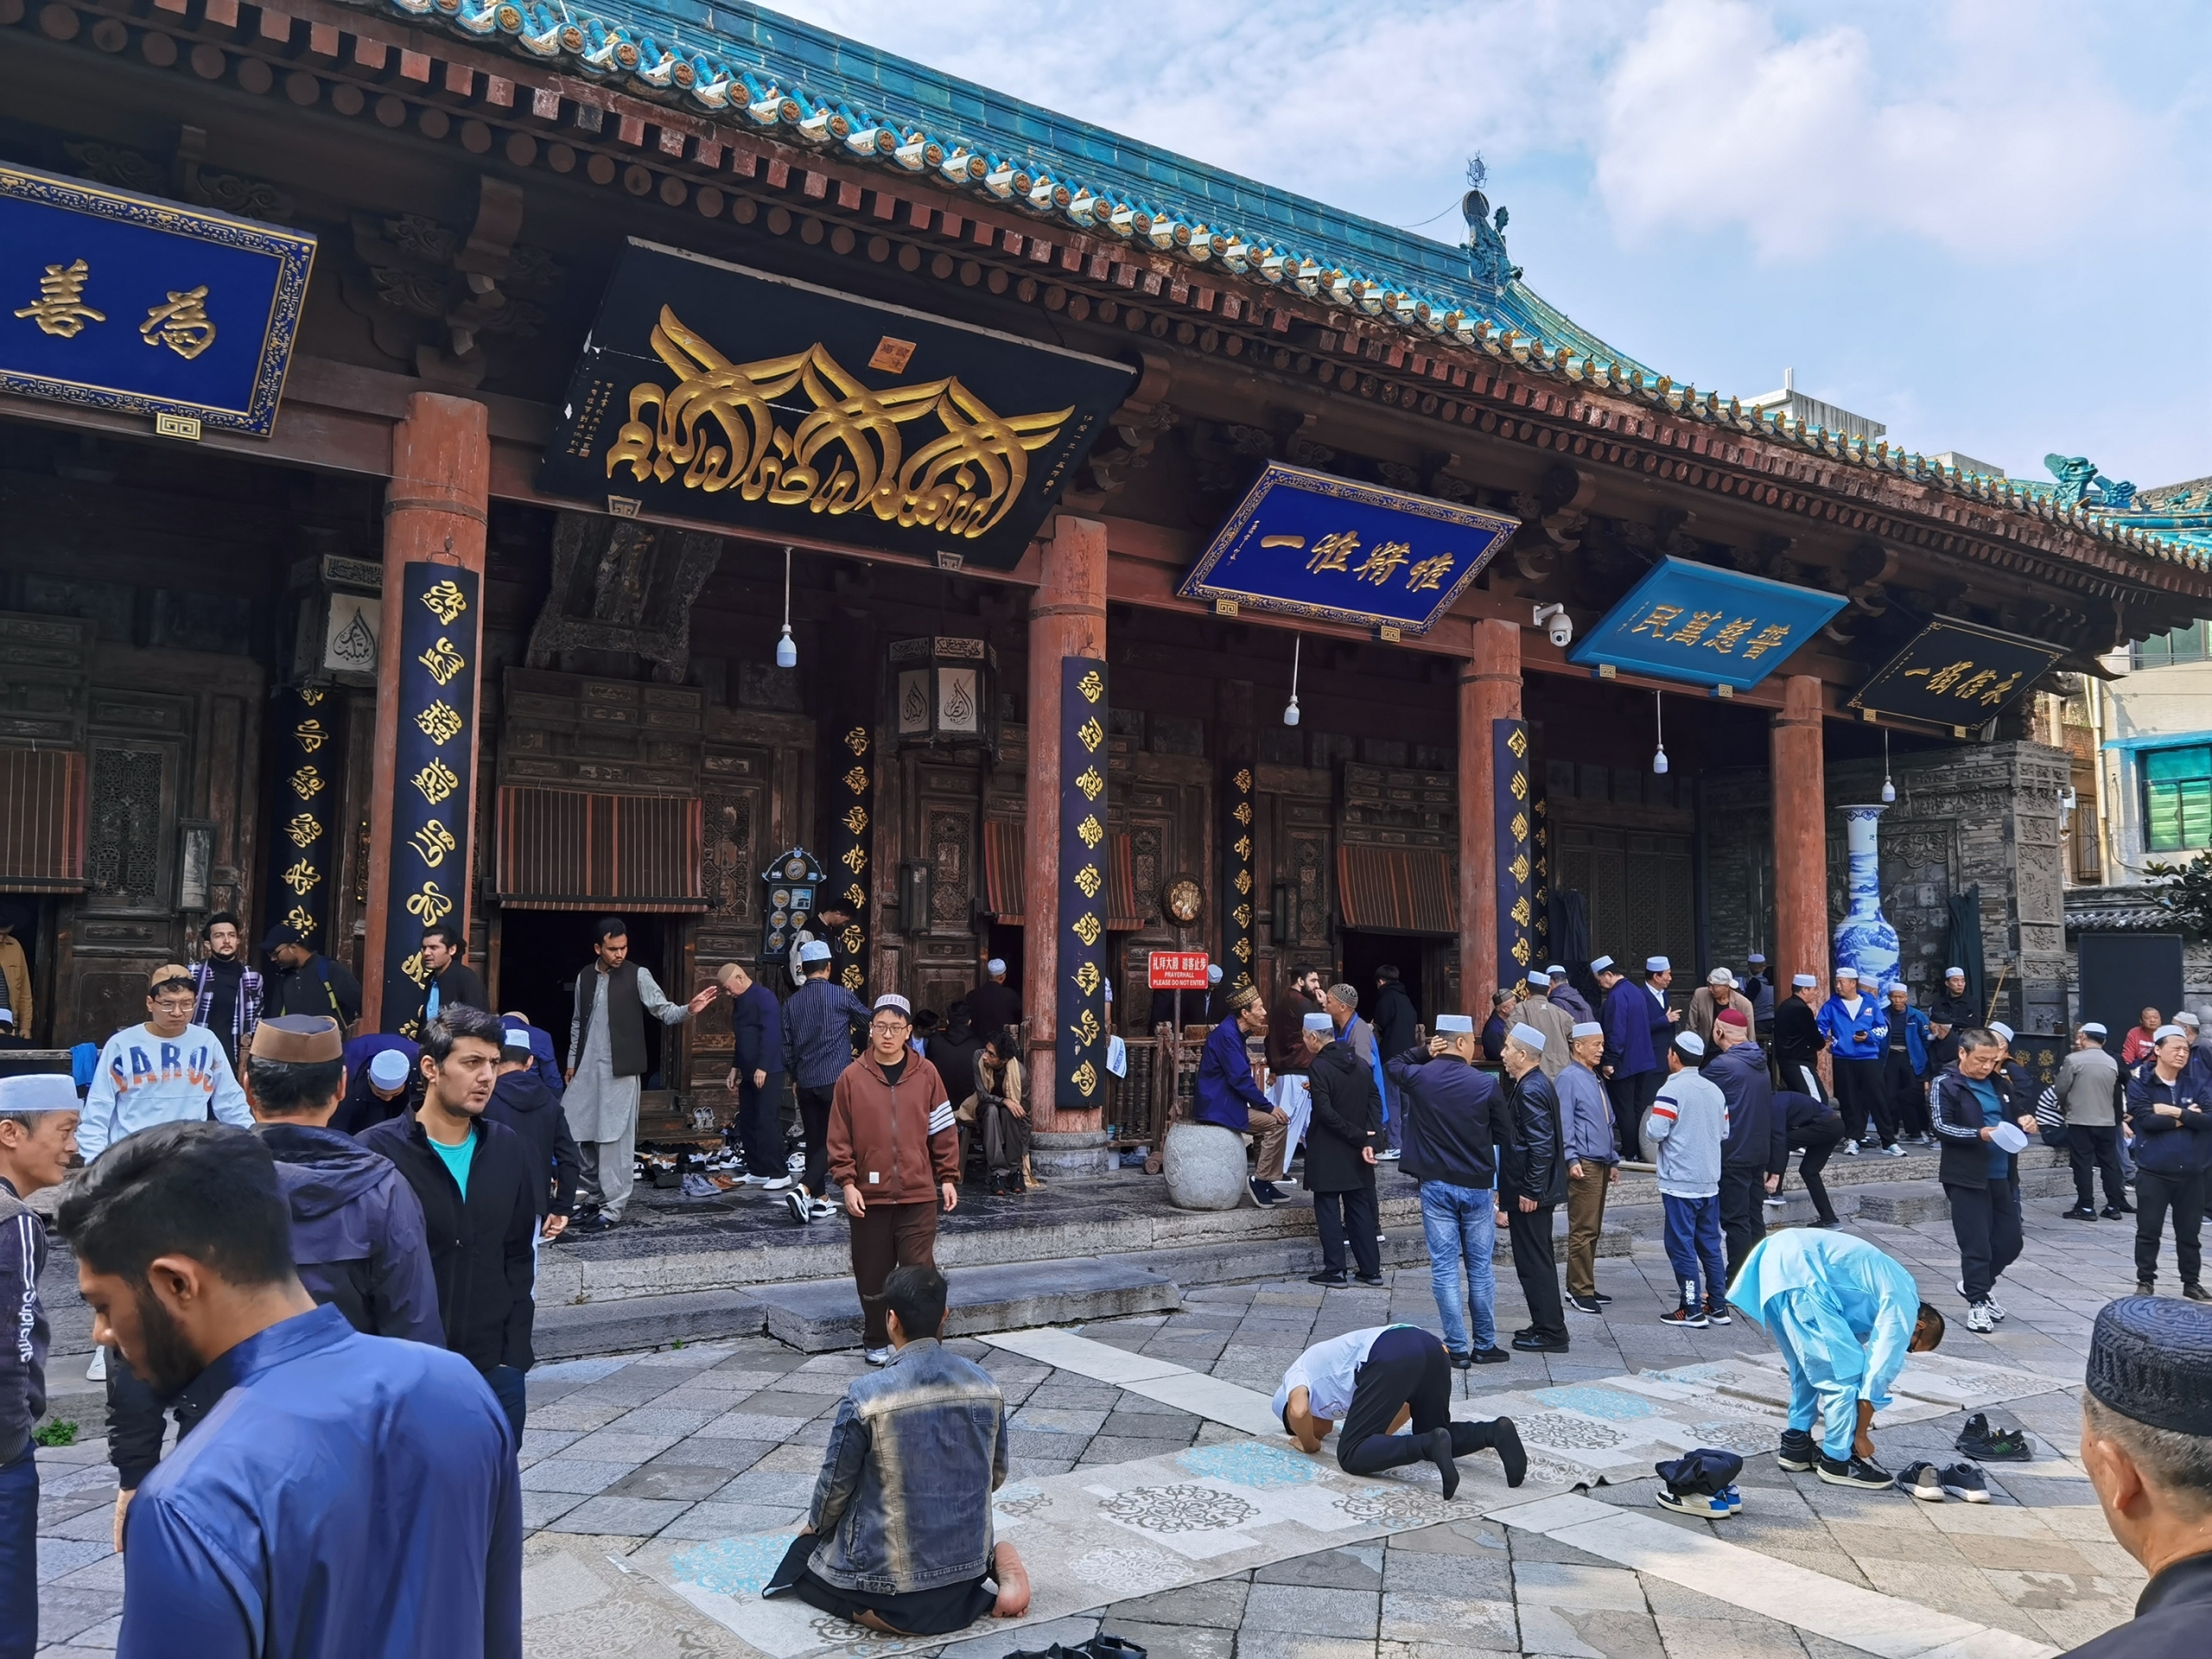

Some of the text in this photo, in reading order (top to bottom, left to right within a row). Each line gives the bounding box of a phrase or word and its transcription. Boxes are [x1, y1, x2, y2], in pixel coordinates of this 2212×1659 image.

[1153, 957, 1206, 970] 礼拜大殿 游客止步
